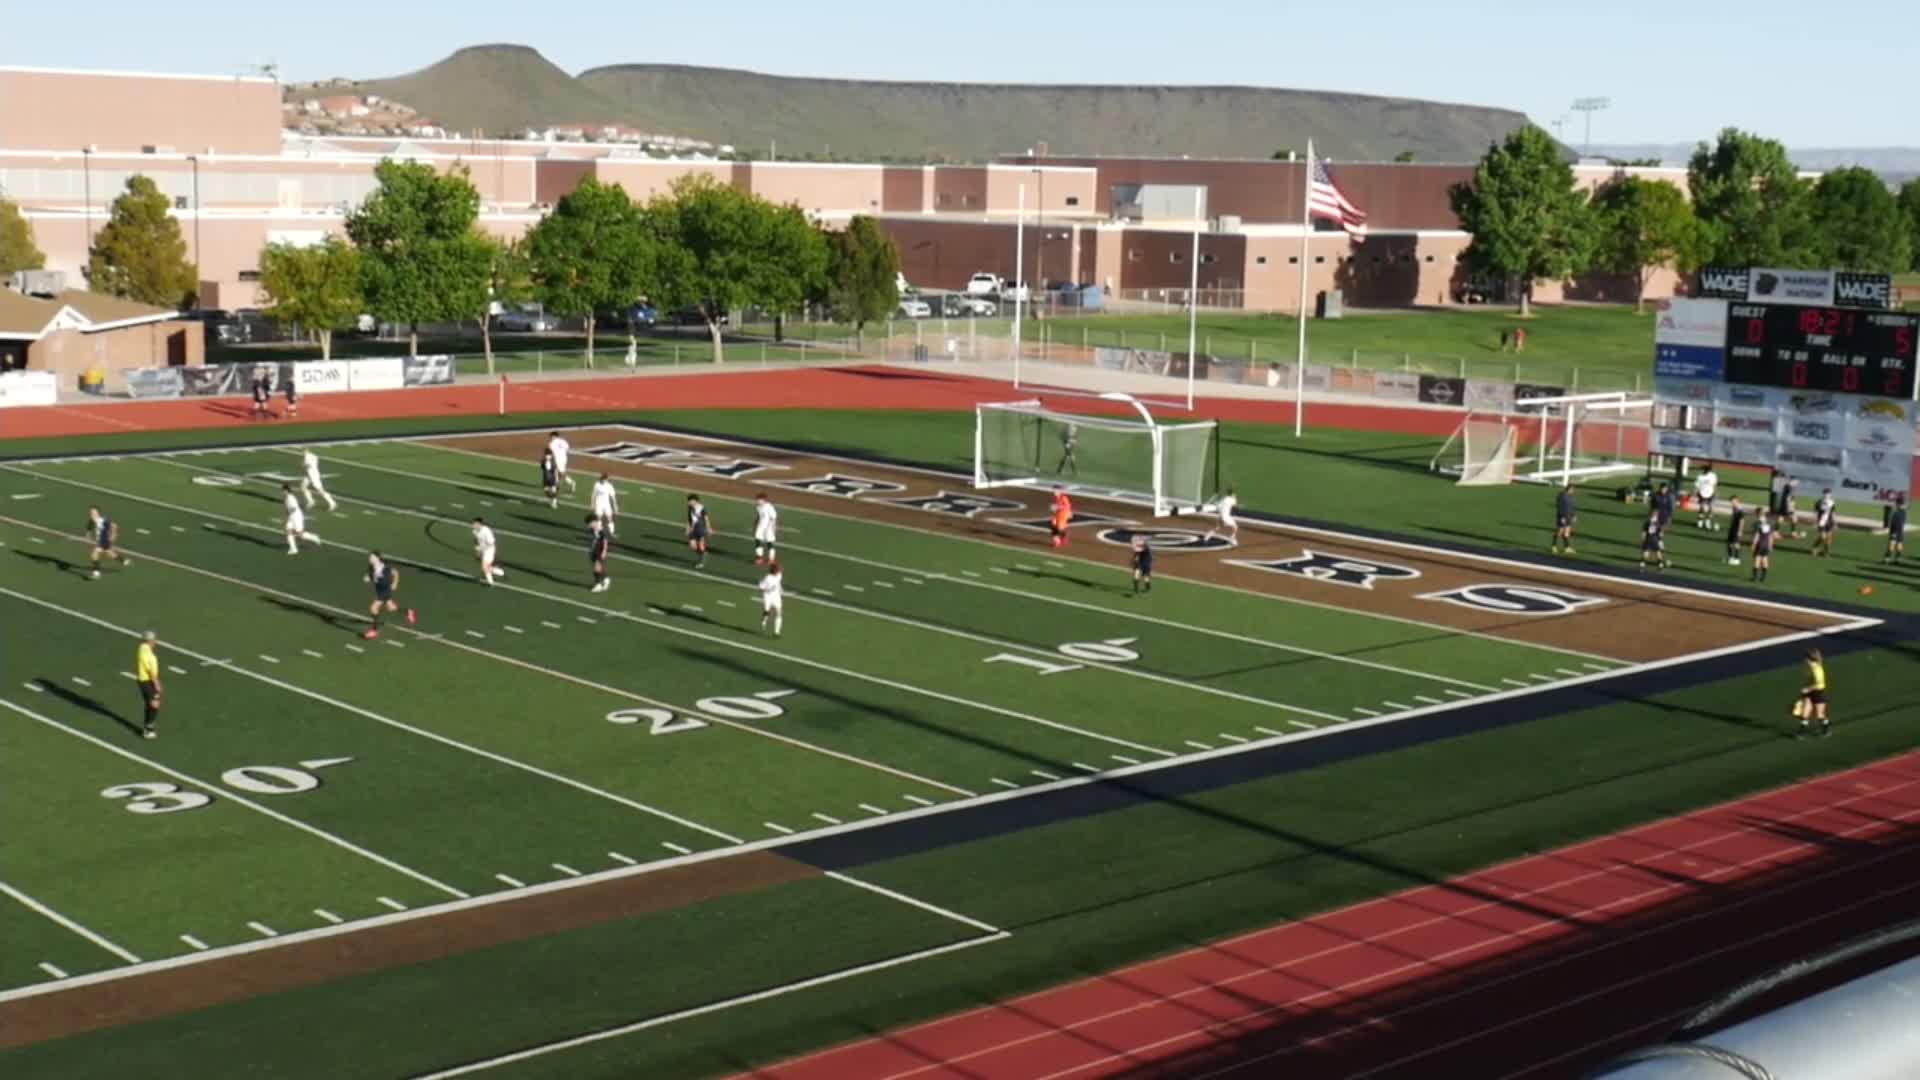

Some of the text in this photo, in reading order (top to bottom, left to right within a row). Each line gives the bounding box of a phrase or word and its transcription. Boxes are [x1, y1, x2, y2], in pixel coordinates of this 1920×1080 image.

[1702, 273, 1748, 292] WADE
[1837, 281, 1888, 300] WADE
[1732, 306, 1766, 317] GUEST
[984, 640, 1141, 675] 10
[605, 694, 785, 735] 20
[100, 764, 320, 813] 30
